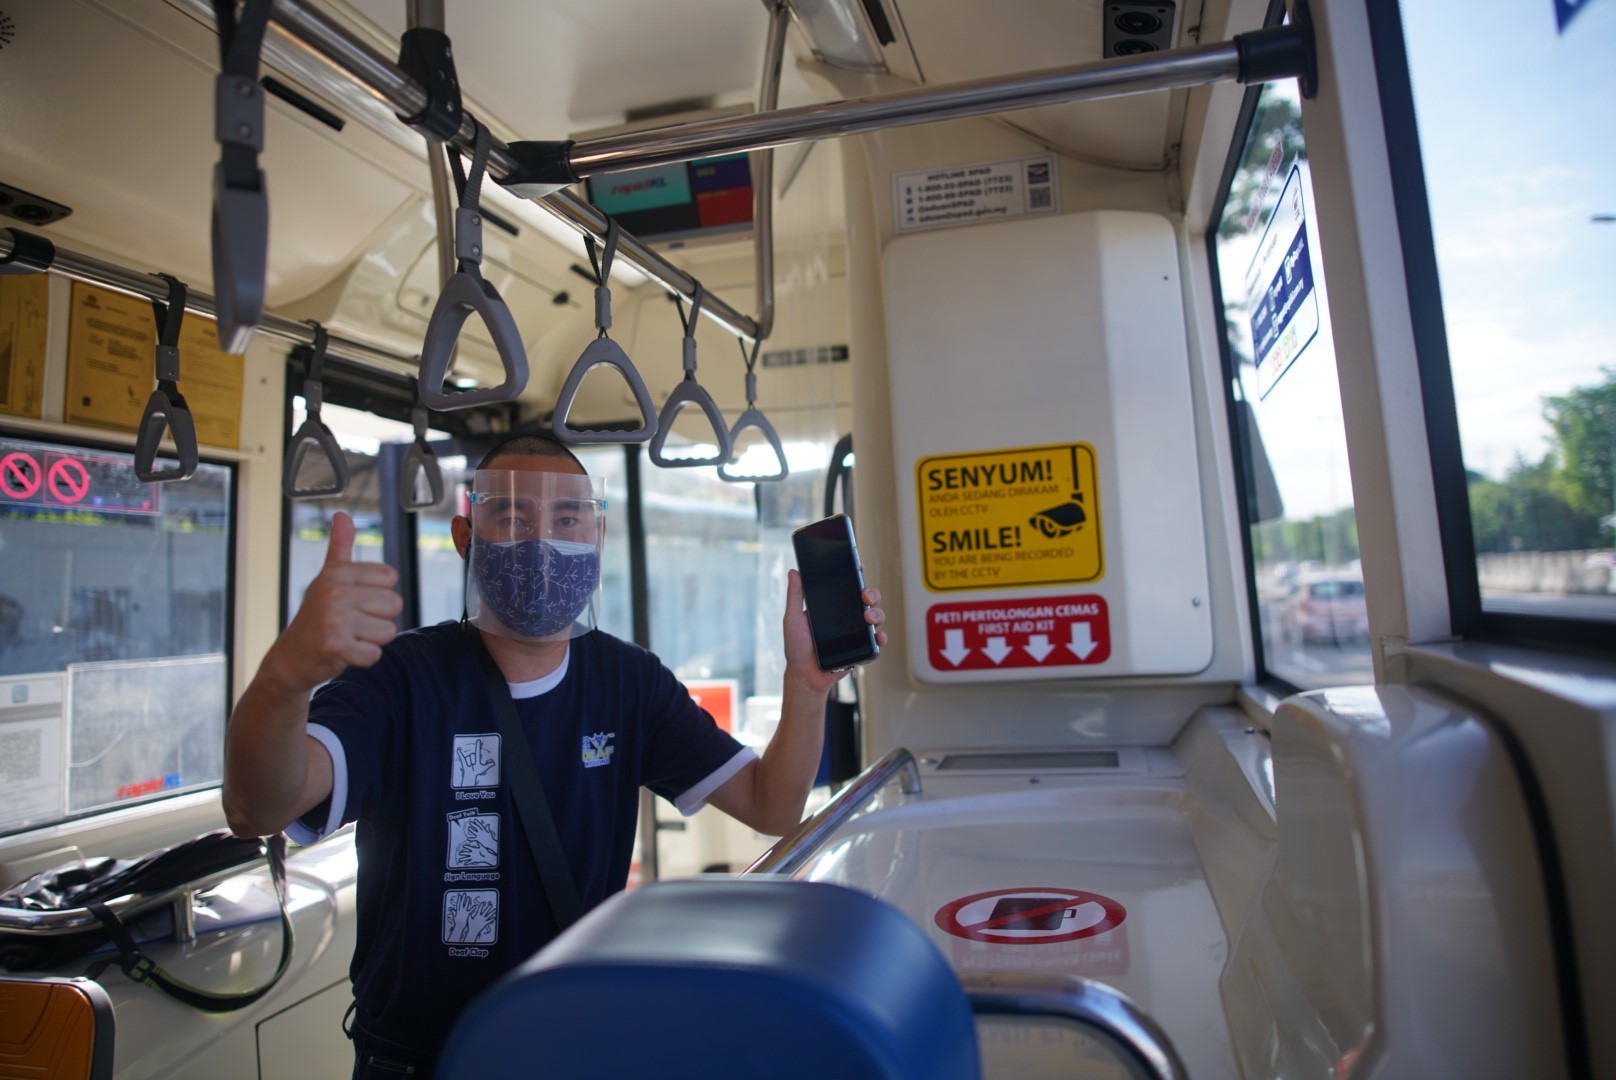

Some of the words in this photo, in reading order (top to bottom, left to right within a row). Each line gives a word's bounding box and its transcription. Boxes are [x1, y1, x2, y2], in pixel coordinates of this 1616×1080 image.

[928, 459, 1053, 491] SENYUM!
[929, 491, 960, 503] ANDA
[961, 488, 1007, 501] SEDANG
[1008, 484, 1059, 496] DIRAKAM
[929, 506, 959, 518] OLEH
[960, 504, 989, 516] CCTV
[932, 526, 1022, 553] SMILE!
[933, 555, 956, 567] YOU
[959, 553, 978, 565] ARE
[981, 551, 1013, 564] BEING
[1015, 547, 1074, 561] RECORDED
[933, 569, 948, 580] BY
[950, 568, 969, 579] THE
[971, 567, 1000, 578] CCTV
[935, 612, 961, 623] PETI
[962, 606, 1054, 622] PERTOLONGAN
[1055, 603, 1099, 617] CEMAS
[978, 622, 1010, 634] FIRST
[1012, 621, 1034, 633] AID
[1036, 620, 1056, 632] KIT
[461, 792, 480, 800] Love
[444, 873, 460, 881] Sign
[461, 872, 500, 881] Language
[449, 948, 468, 957] Deaf
[469, 948, 489, 958] Clap
